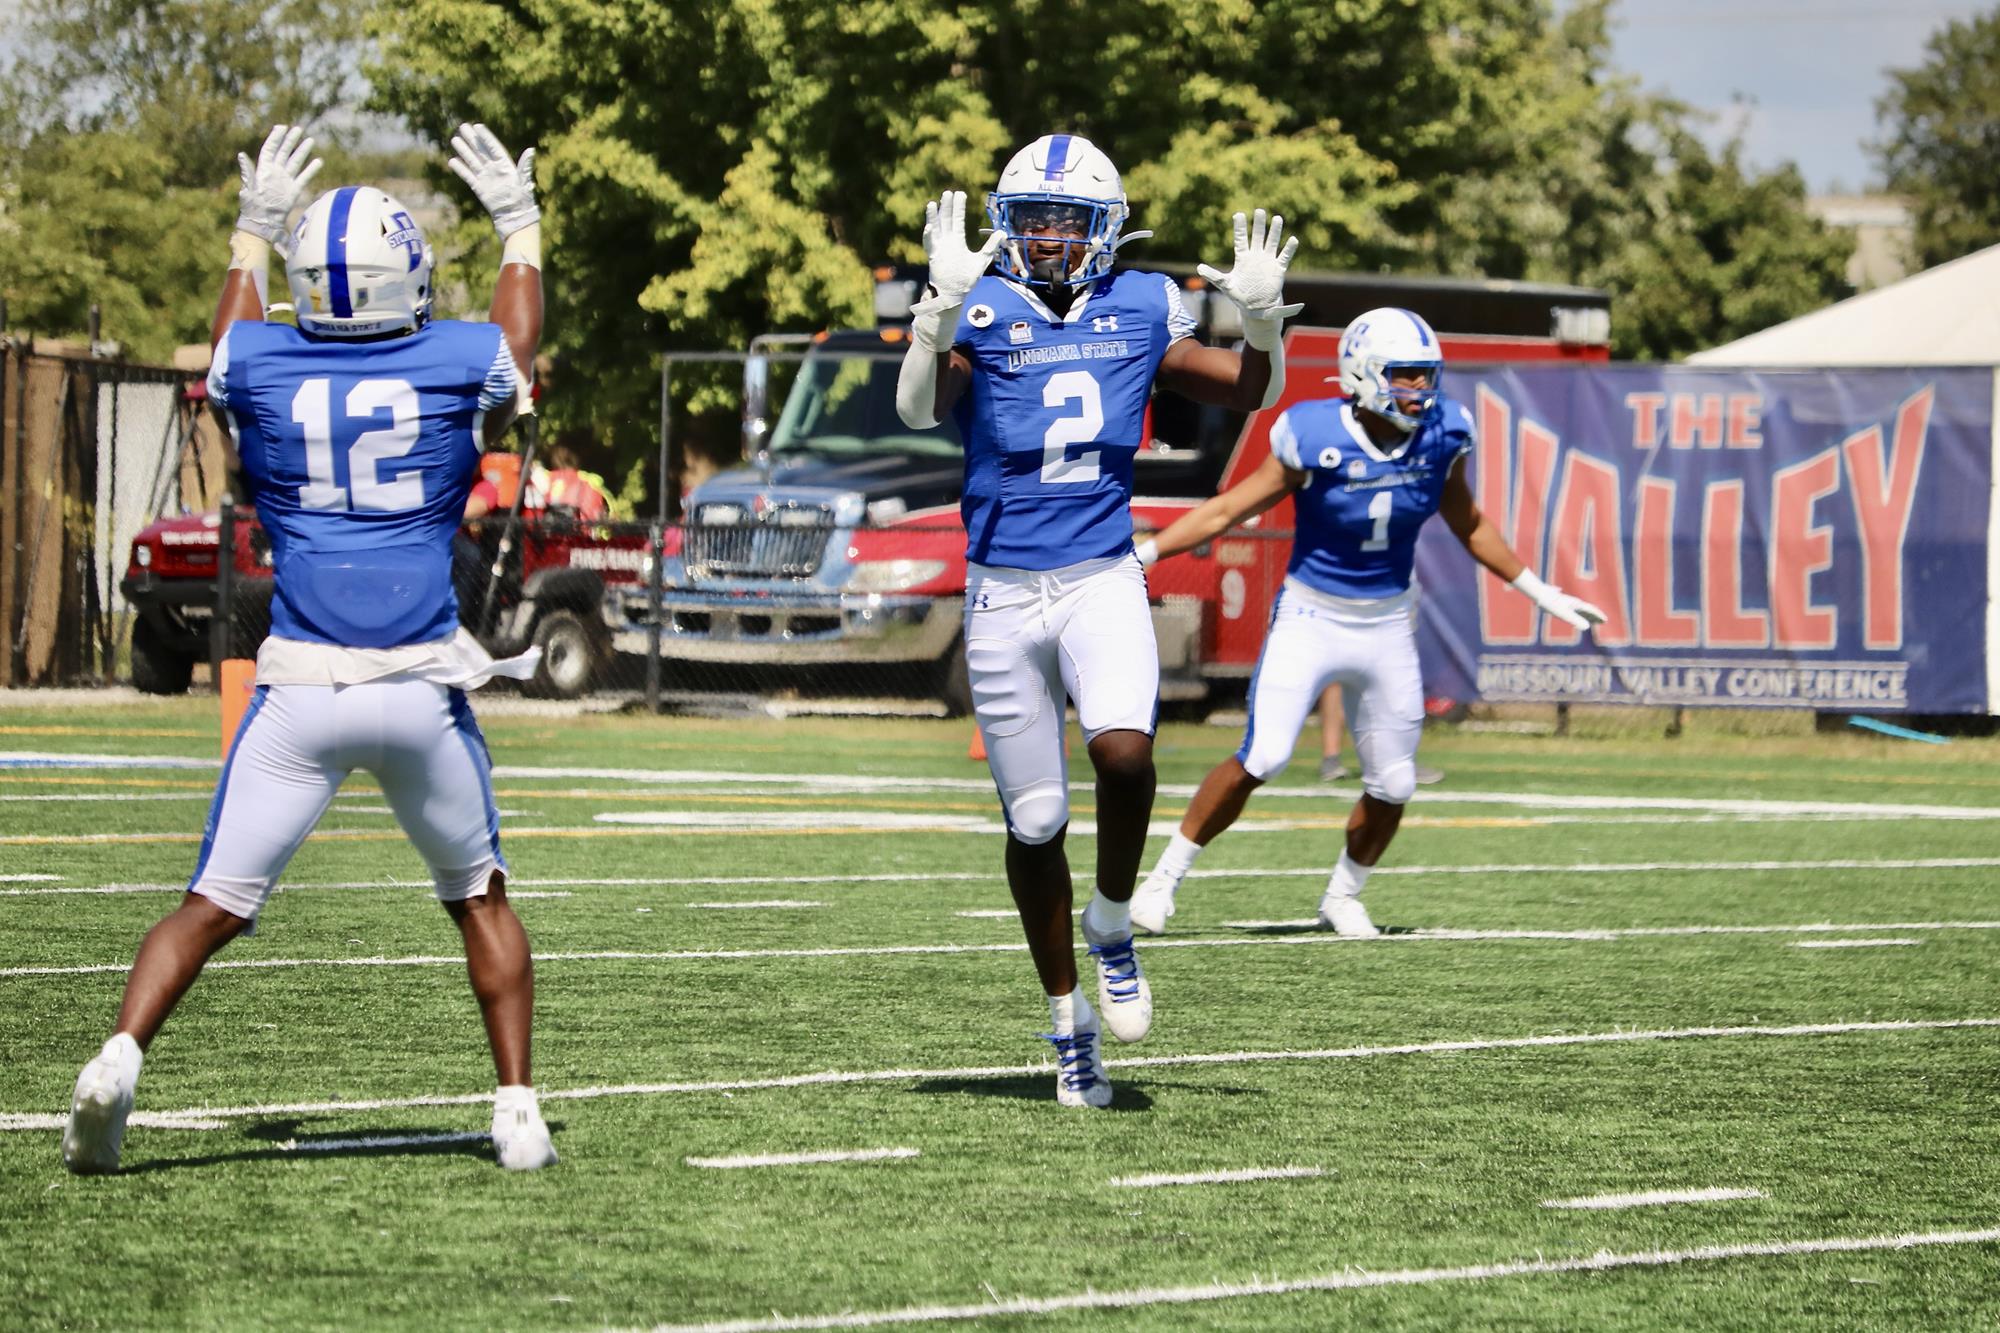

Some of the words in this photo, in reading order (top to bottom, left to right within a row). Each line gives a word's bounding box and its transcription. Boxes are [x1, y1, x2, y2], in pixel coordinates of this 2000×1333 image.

[1008, 344, 1081, 372] INDIANA
[1082, 340, 1128, 359] STATE
[292, 378, 425, 511] 12
[1040, 370, 1104, 483] 2
[1625, 393, 1764, 449] THE
[1361, 491, 1393, 551] 1
[1476, 383, 1935, 650] VALLEY
[1221, 568, 1246, 619] 9
[1477, 663, 1611, 693] MISSOURI
[1618, 667, 1722, 697] VALLEY
[1726, 668, 1907, 700] CONFERENCE
